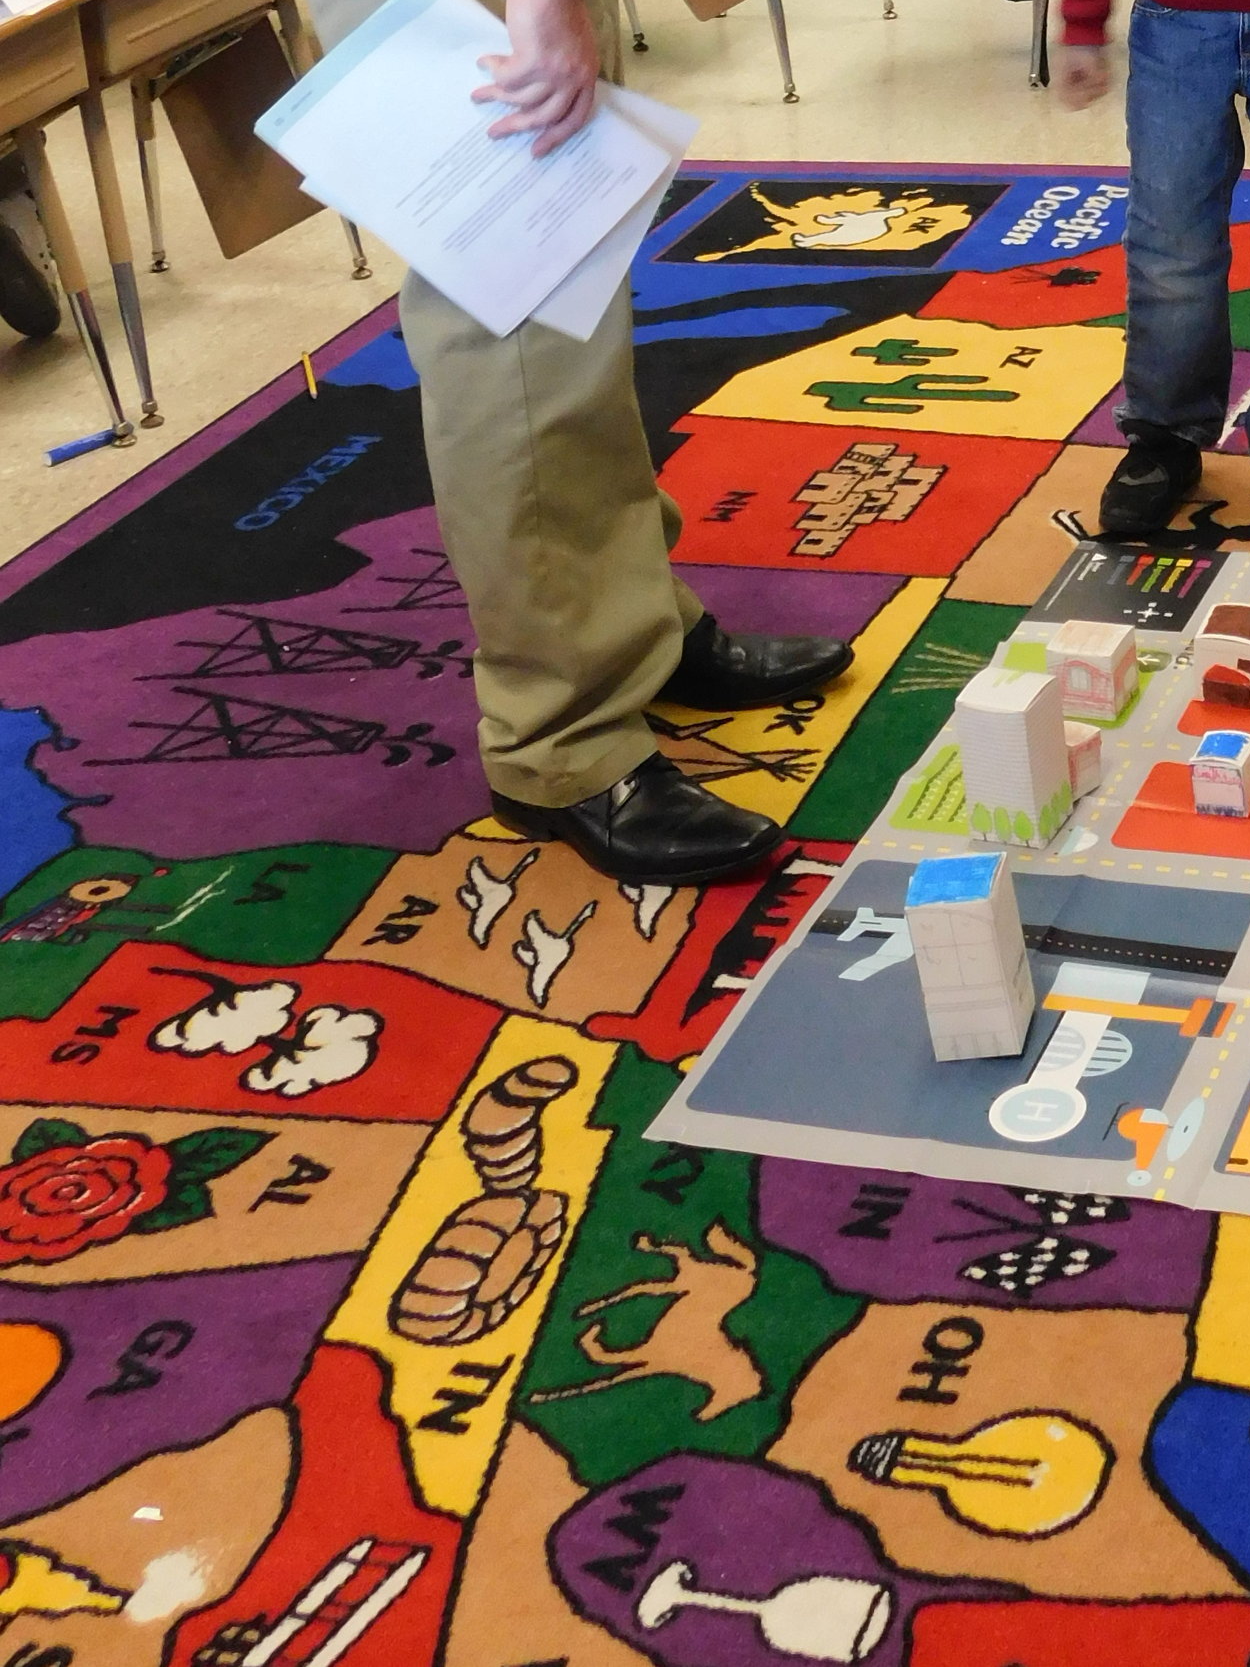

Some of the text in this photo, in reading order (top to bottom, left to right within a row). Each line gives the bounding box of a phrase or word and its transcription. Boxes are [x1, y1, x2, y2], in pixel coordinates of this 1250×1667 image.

[903, 216, 941, 235] AK
[1000, 185, 1081, 245] Ocean
[1050, 184, 1130, 249] Pacific
[999, 346, 1042, 368] AZ
[234, 435, 382, 532] MEXICO
[766, 695, 825, 735] OK
[235, 862, 310, 905] LA
[362, 894, 440, 945] AR
[51, 1004, 140, 1066] MS
[249, 1153, 332, 1213] AL
[839, 1184, 909, 1239] IN
[89, 1321, 196, 1399] GA
[897, 1316, 984, 1404] OH
[416, 1354, 513, 1435] TN
[581, 1484, 685, 1591] WV
